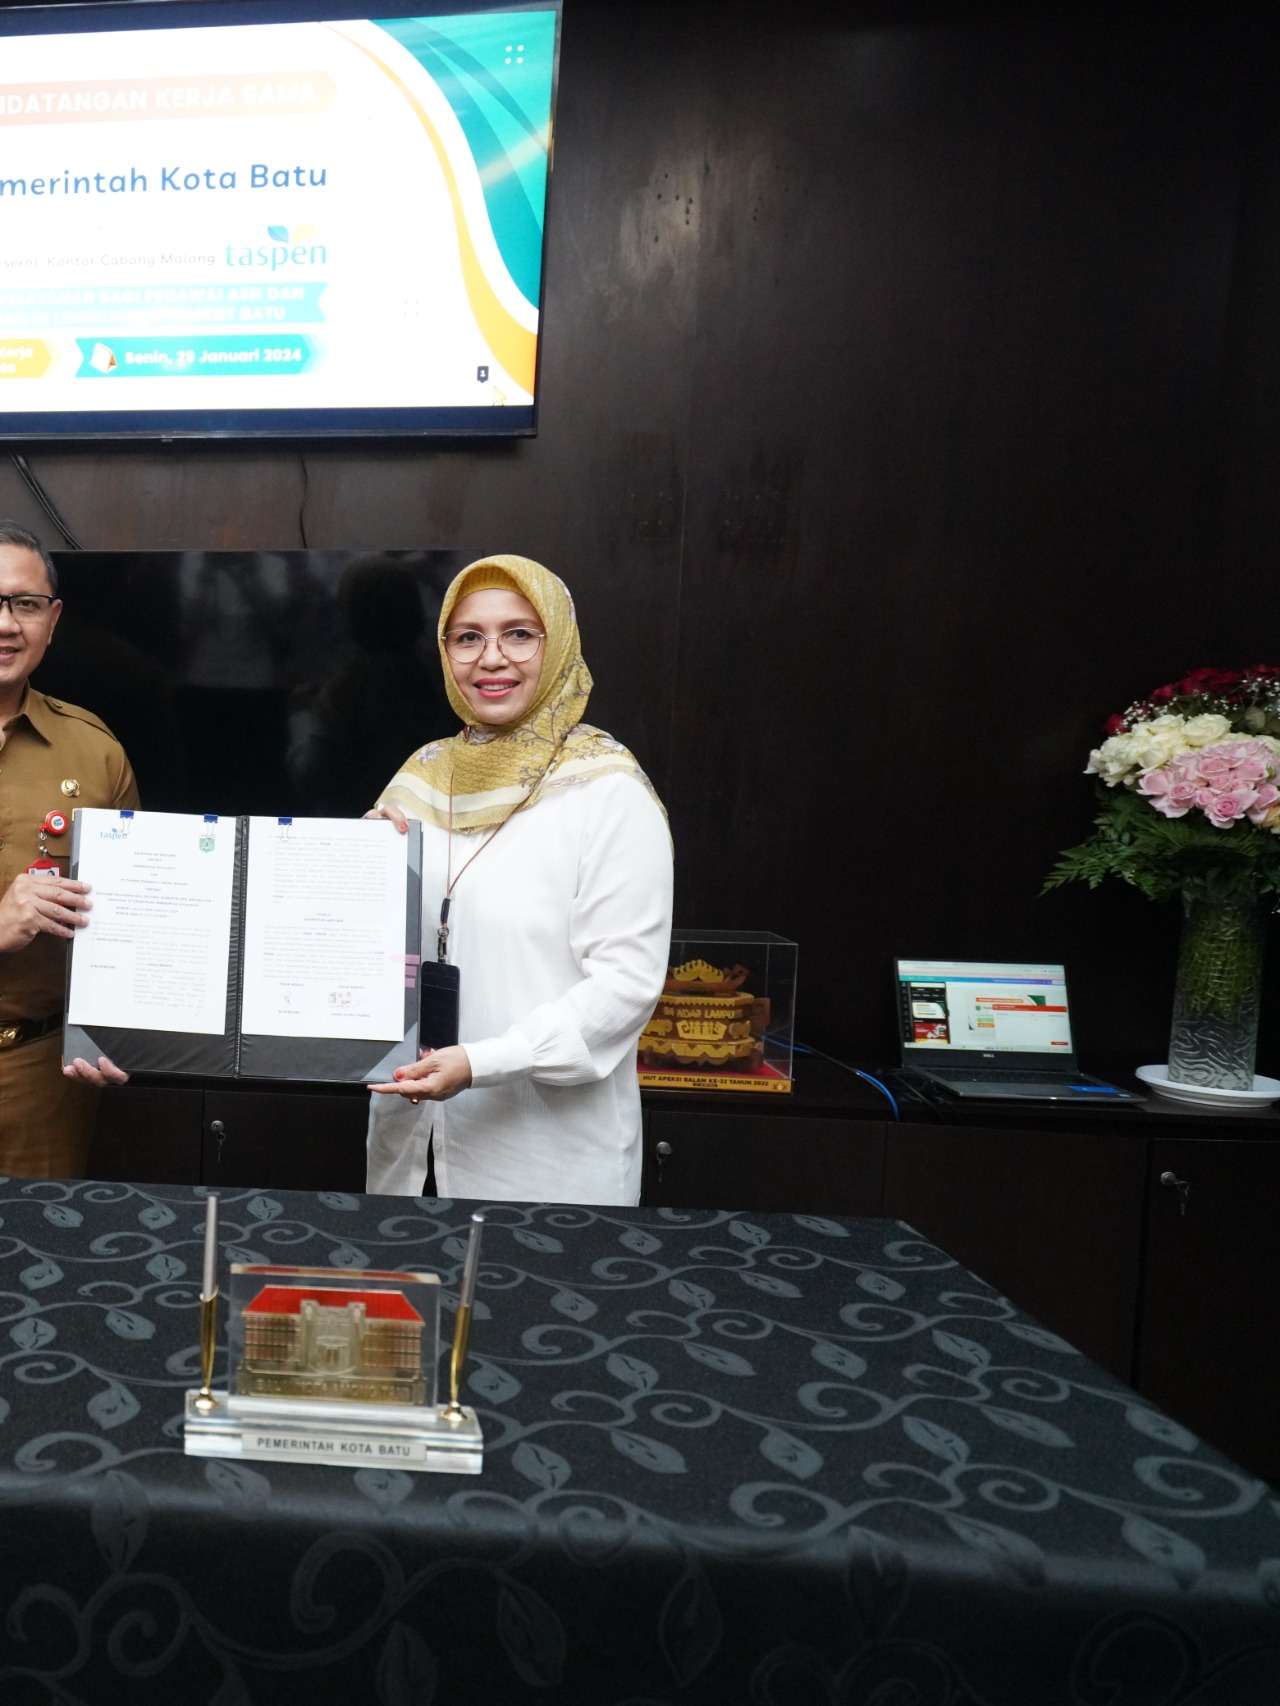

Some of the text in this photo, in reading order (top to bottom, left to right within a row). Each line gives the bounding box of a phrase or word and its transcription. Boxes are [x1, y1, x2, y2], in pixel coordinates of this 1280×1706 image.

[156, 83, 236, 113] KERJA
[160, 165, 238, 192] Kota
[250, 163, 327, 189] Batu
[225, 239, 327, 271] taspen
[199, 347, 260, 364] Januari
[264, 347, 303, 363] 2024
[256, 1437, 411, 1456] PEMERINTAH KOTA BATU
